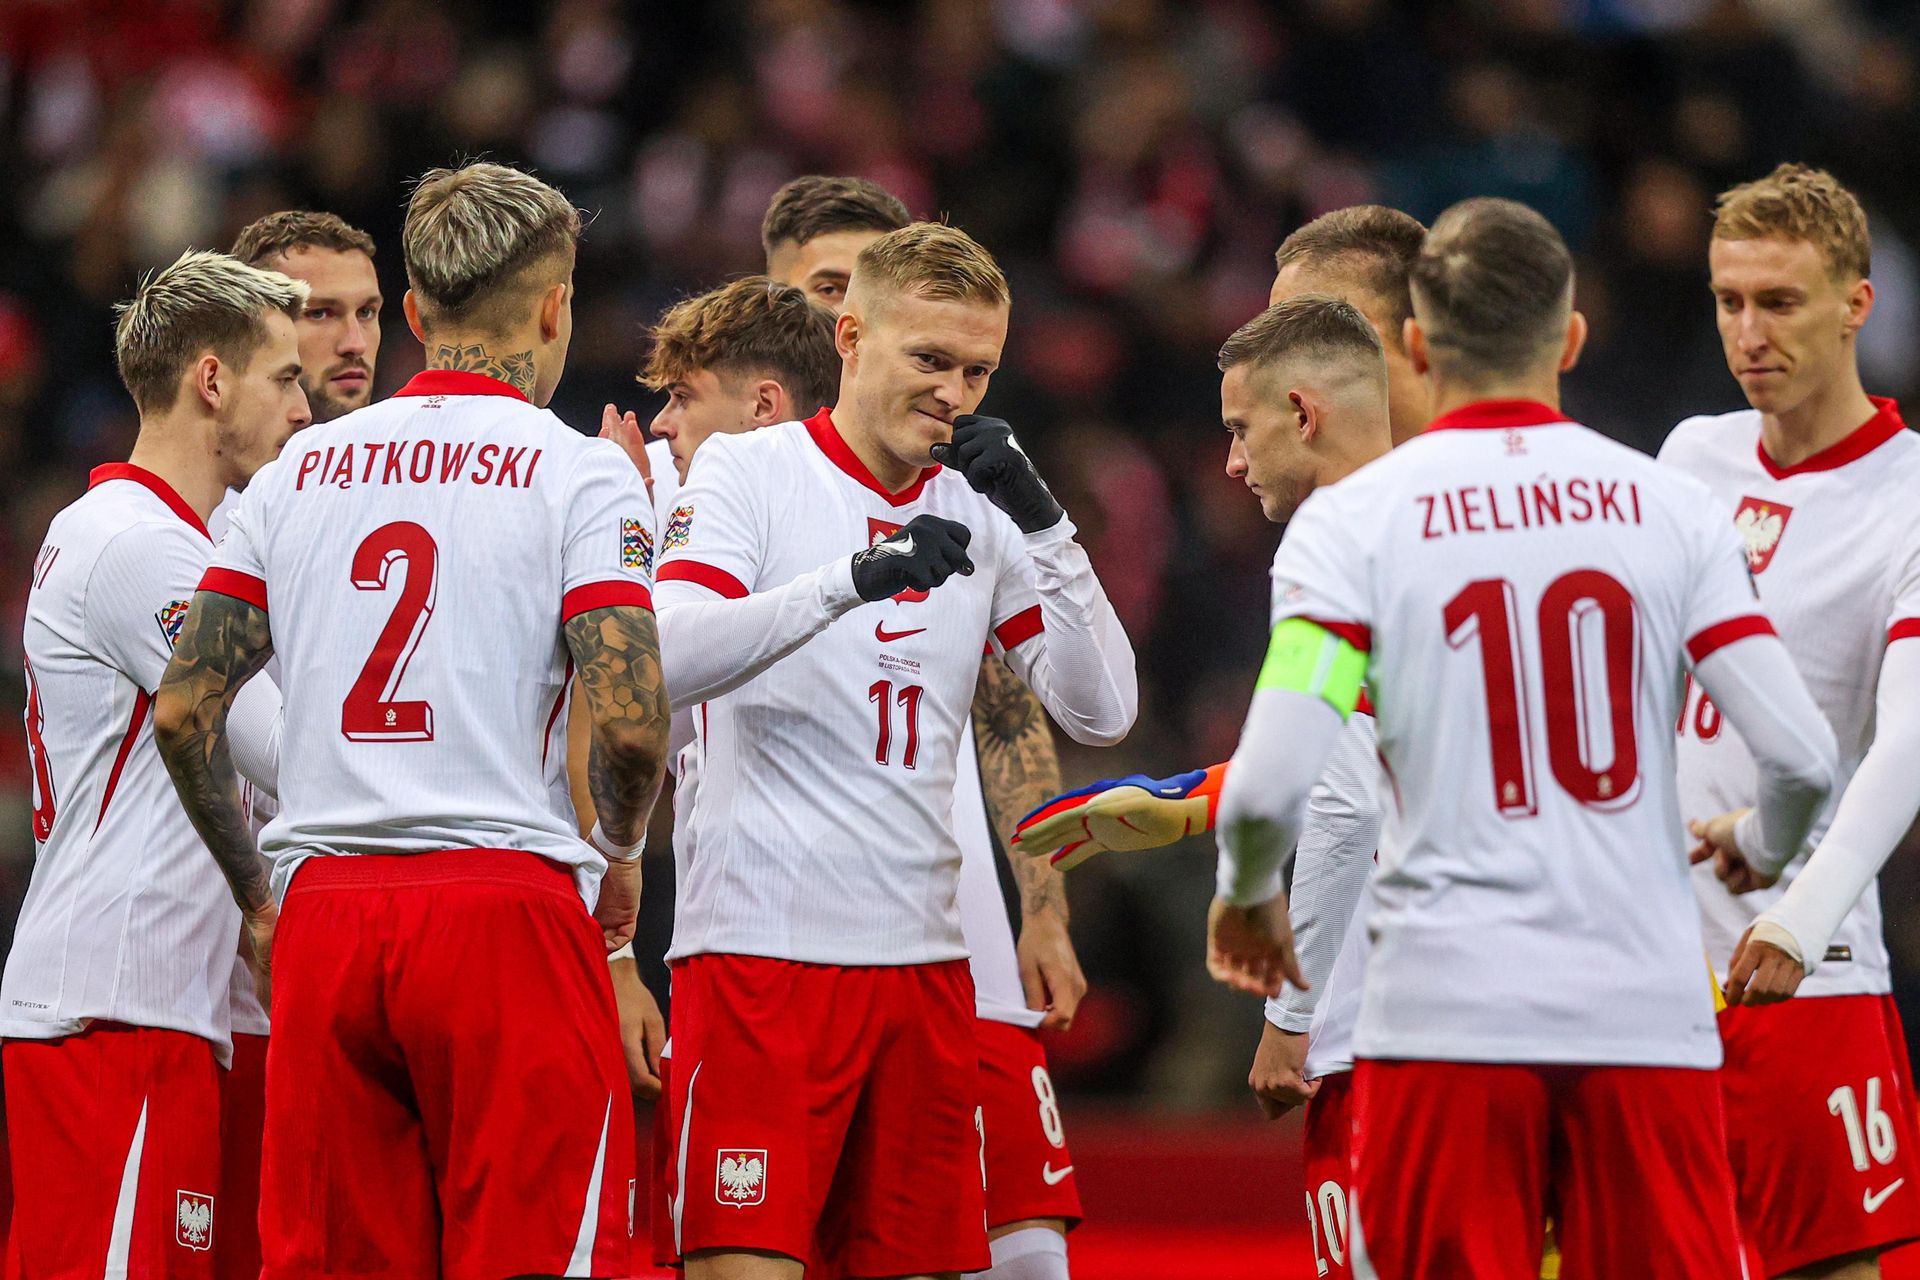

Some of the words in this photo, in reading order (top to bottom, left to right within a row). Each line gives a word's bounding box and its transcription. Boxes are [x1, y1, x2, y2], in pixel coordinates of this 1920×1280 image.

[295, 439, 543, 491] PIĄTKOWSKI
[1416, 473, 1642, 541] ZIELIŃSKI
[341, 520, 439, 743] 2
[868, 679, 924, 770] 11
[1442, 568, 1644, 821] 10
[1031, 1065, 1066, 1149] 8
[1826, 1076, 1898, 1172] 16
[1305, 1180, 1348, 1278] 20
